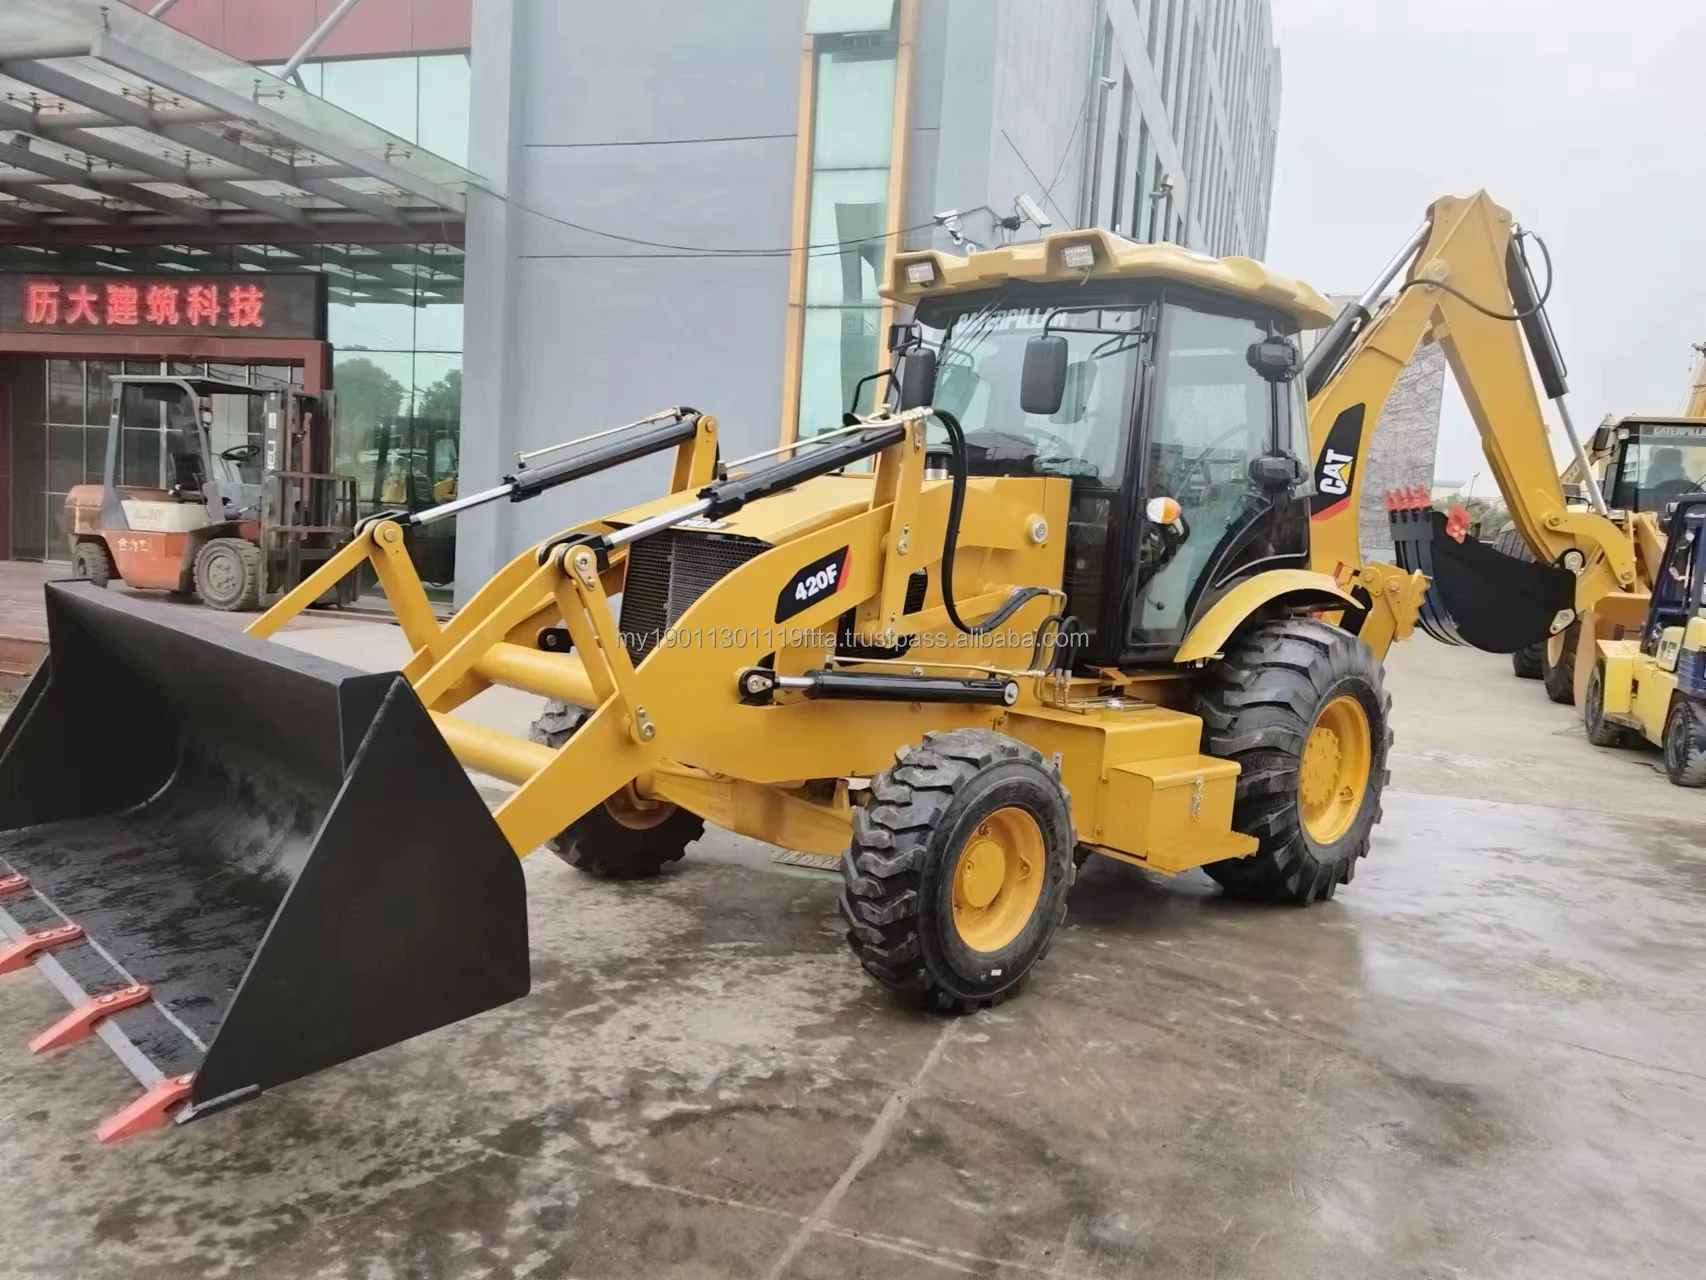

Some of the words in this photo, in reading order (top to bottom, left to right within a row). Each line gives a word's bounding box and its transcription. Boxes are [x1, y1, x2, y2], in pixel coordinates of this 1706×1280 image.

[27, 284, 264, 327] 历大建筑科技
[1320, 448, 1354, 495] CAT
[795, 563, 838, 600] 420F
